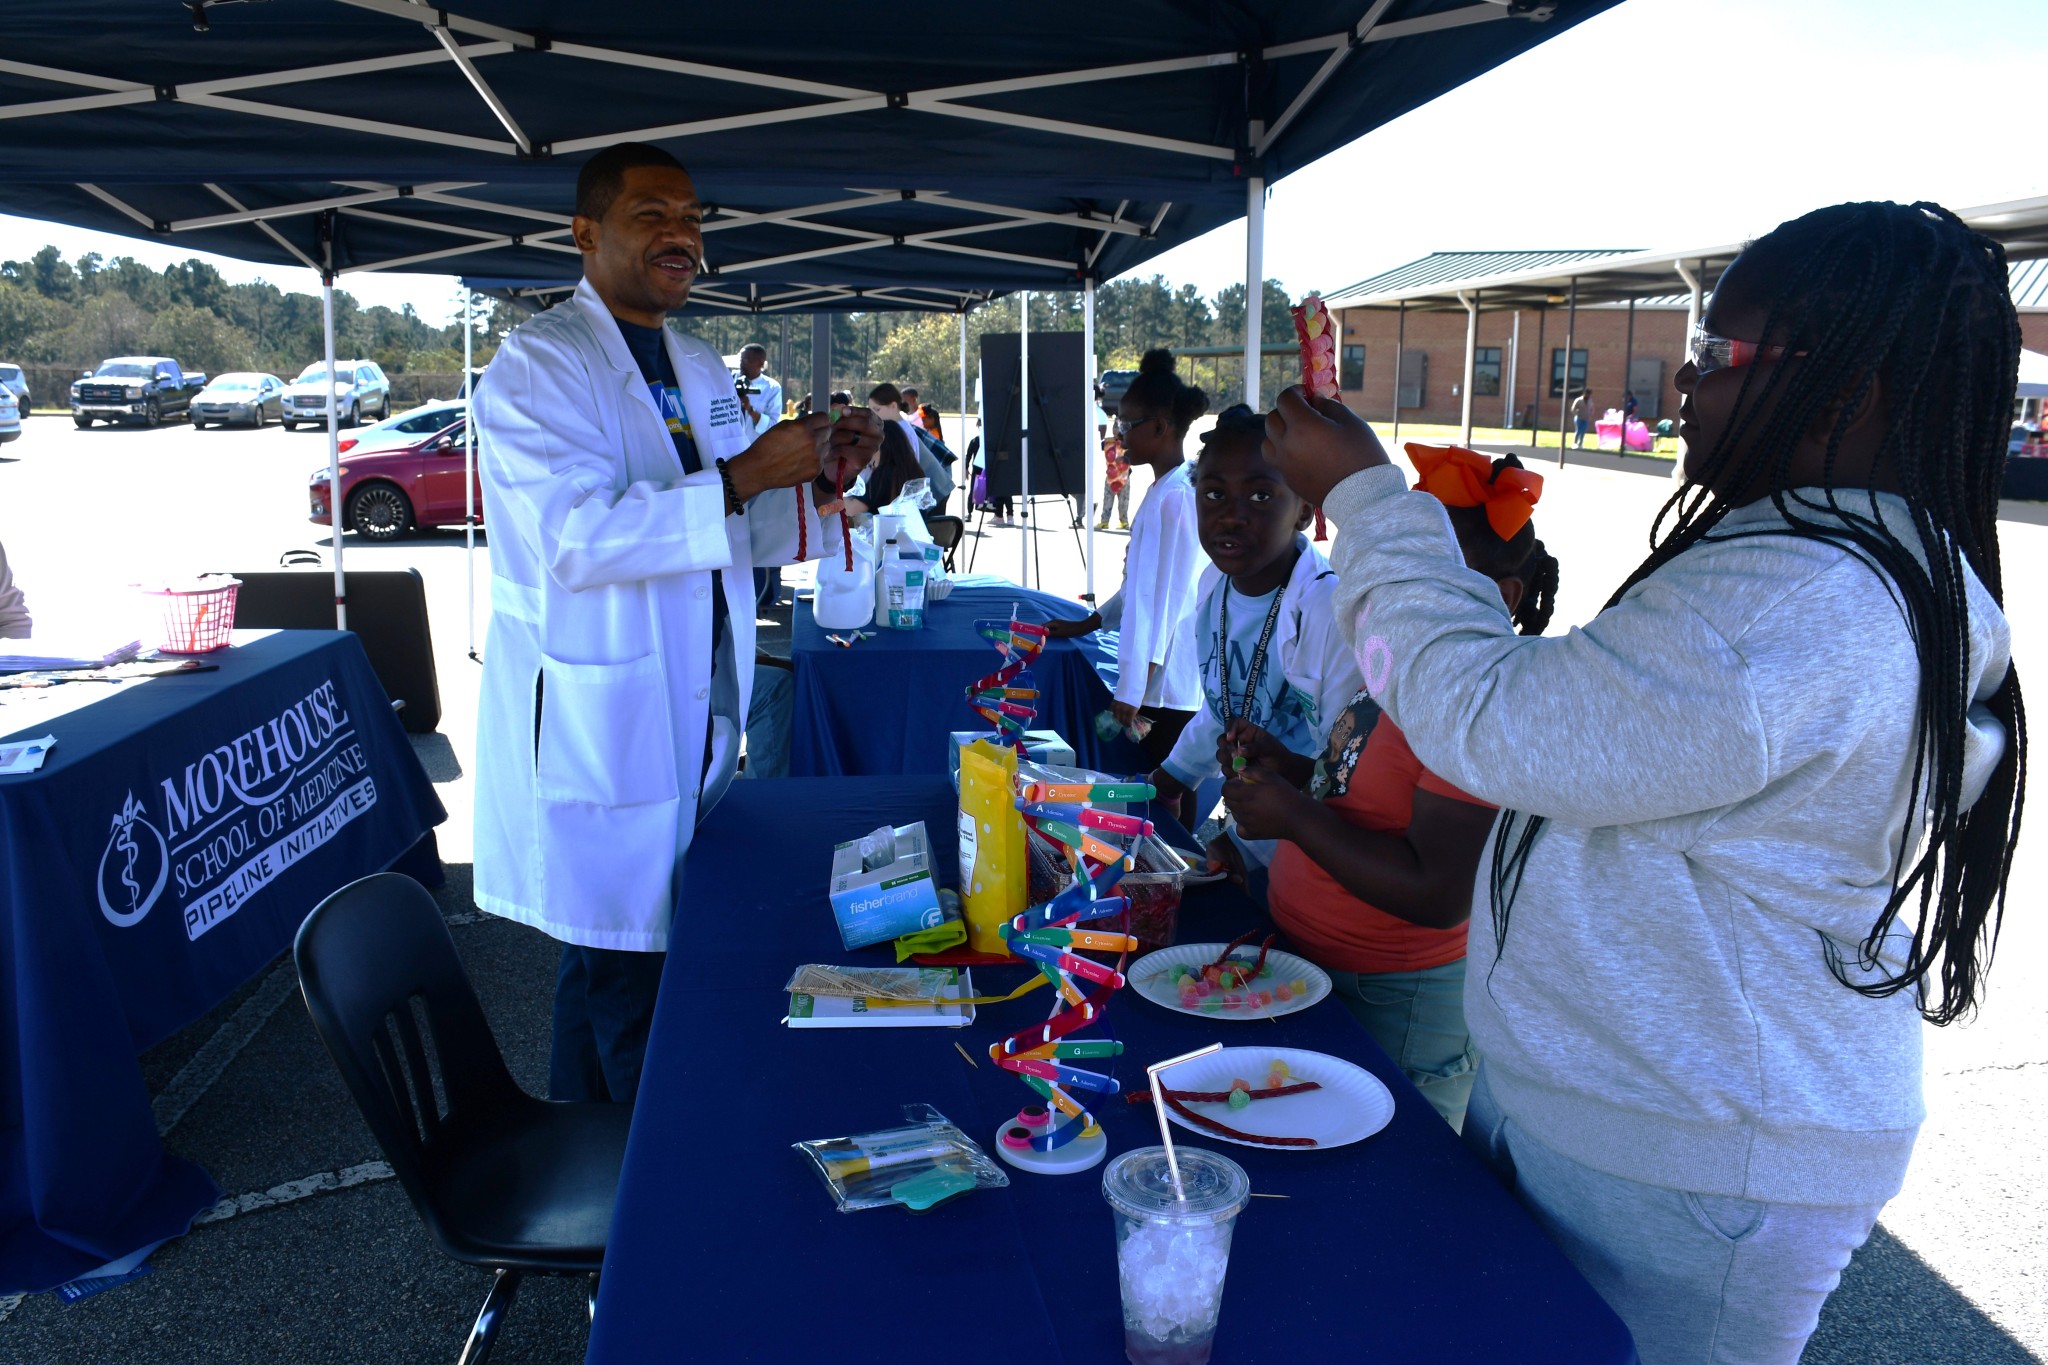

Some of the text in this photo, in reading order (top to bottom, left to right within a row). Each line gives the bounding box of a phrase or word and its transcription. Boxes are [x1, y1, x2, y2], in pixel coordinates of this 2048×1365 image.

[1270, 587, 1286, 617] PROGRAM
[1258, 616, 1275, 651] EDUCATION
[1255, 651, 1265, 670] ADULT
[1246, 670, 1259, 696] COLLEGE
[161, 680, 349, 841] MOREHOUSE
[1048, 789, 1056, 797] C
[1107, 790, 1115, 798] G
[1036, 804, 1044, 813] A
[175, 743, 367, 898] SCHOOL OF MEDICINE
[1097, 816, 1104, 824] T
[1047, 822, 1053, 831] G
[1090, 844, 1097, 853] C
[185, 781, 376, 935] PIPELINE INITIATIVES
[850, 888, 918, 915] fisherbrand
[1091, 907, 1097, 915] A
[1085, 936, 1092, 944] C
[1023, 944, 1030, 952] A
[1074, 961, 1080, 970] T
[1015, 1059, 1021, 1068] T
[1071, 1075, 1078, 1083] A
[1058, 1098, 1064, 1106] C
